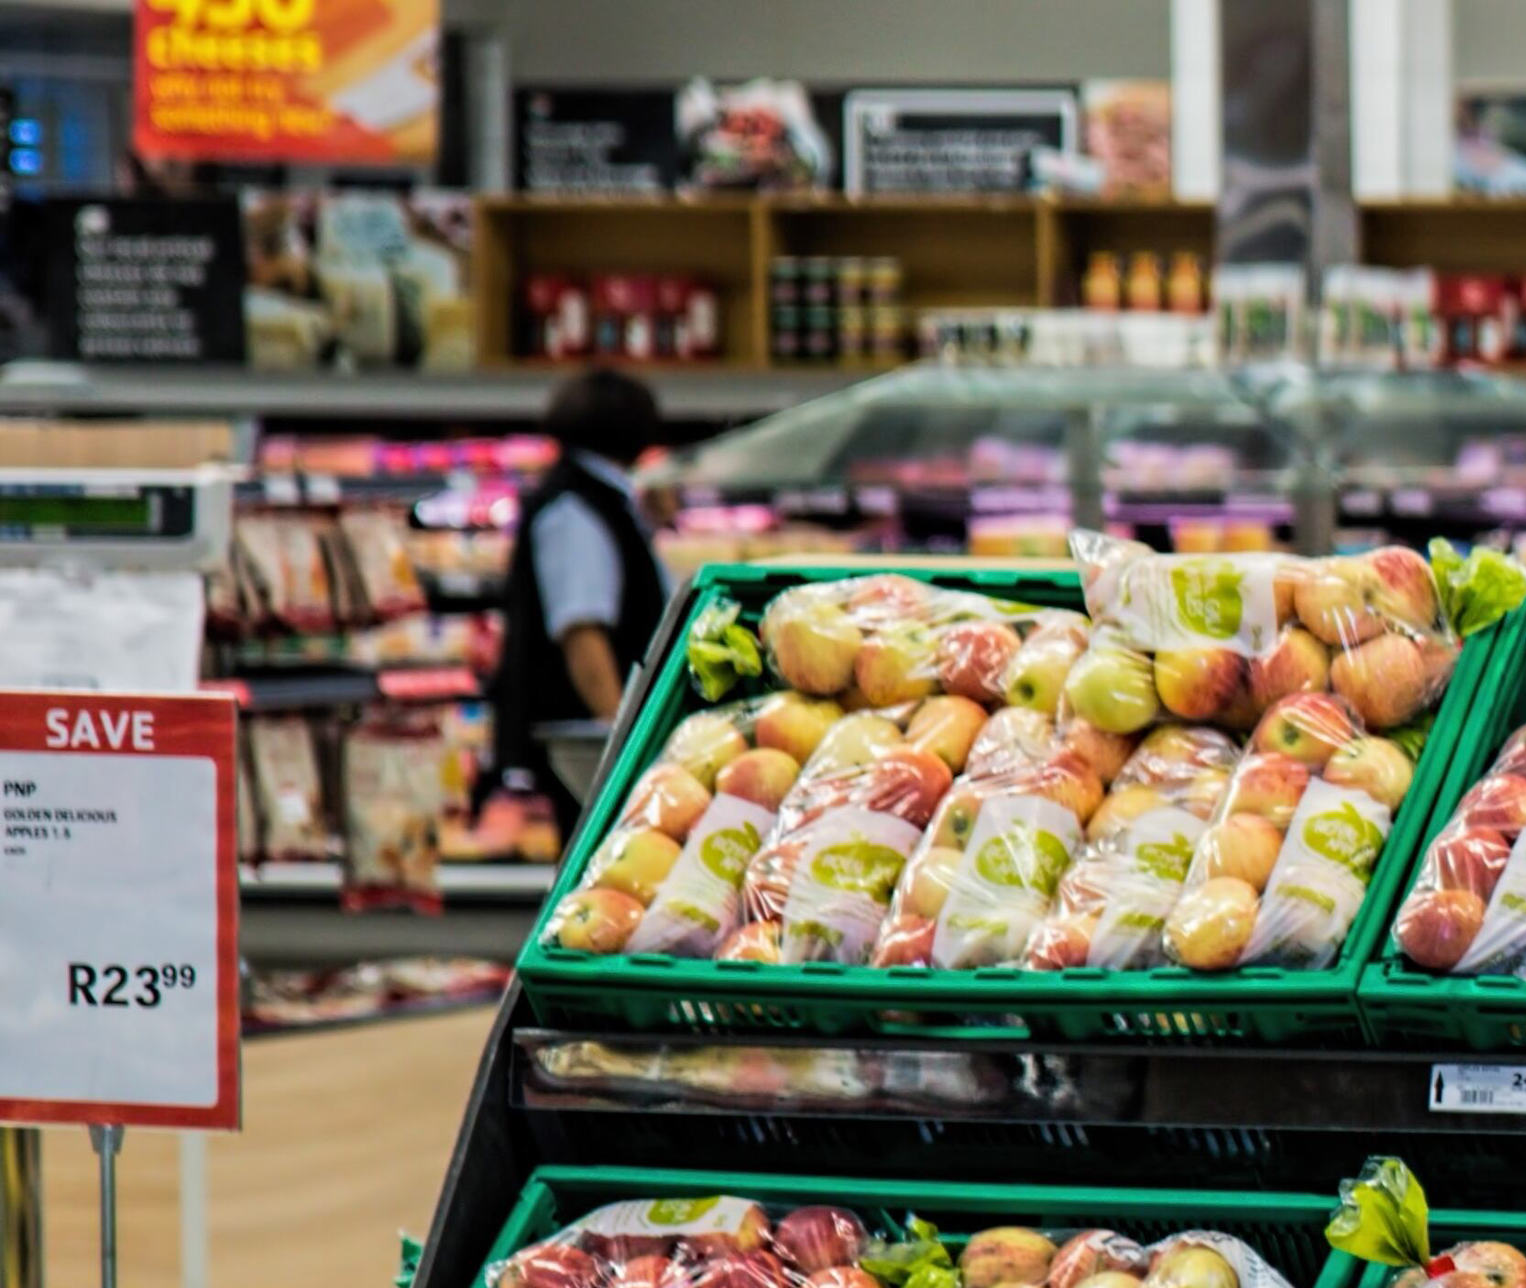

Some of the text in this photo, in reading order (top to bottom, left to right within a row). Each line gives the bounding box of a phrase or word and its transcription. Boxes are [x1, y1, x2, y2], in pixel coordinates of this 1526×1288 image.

[45, 708, 155, 751] SAVE
[3, 779, 37, 797] PNP
[3, 807, 52, 822] GOLDEN
[5, 825, 49, 840] APPLES
